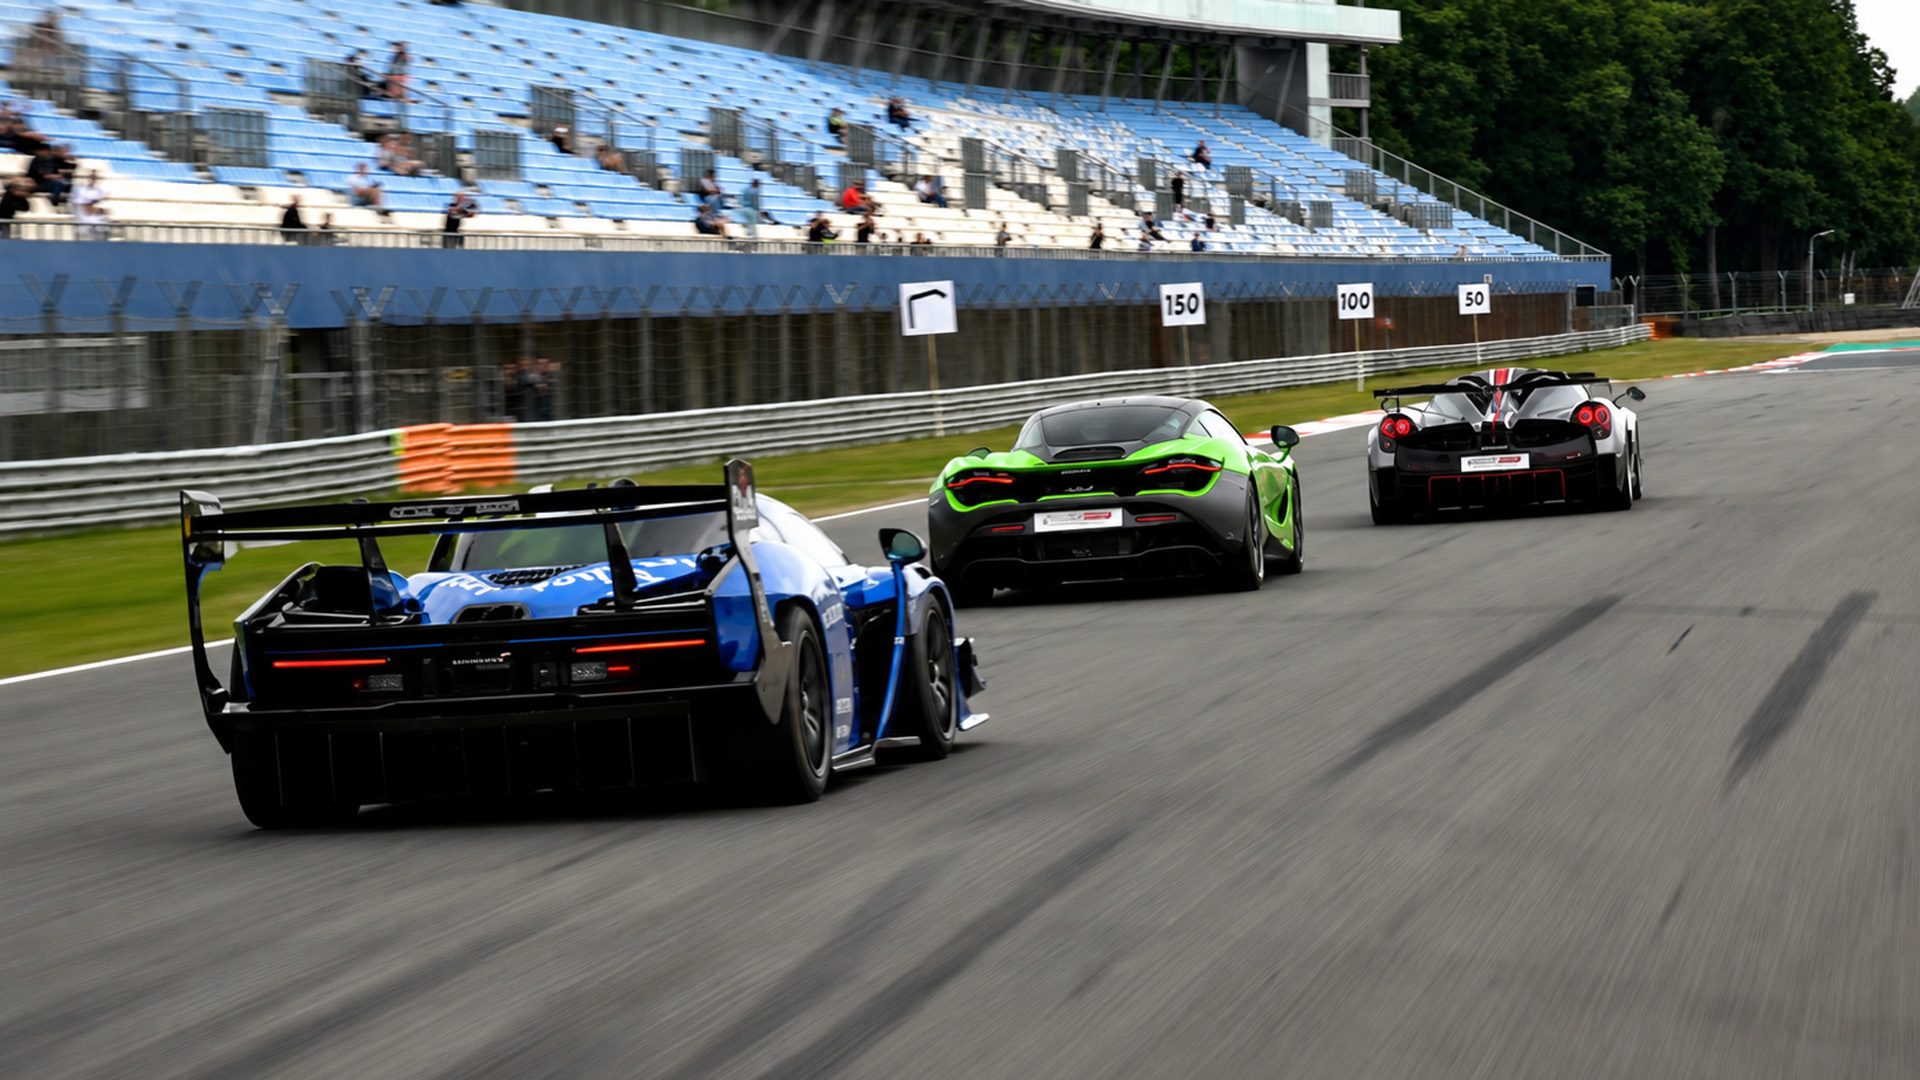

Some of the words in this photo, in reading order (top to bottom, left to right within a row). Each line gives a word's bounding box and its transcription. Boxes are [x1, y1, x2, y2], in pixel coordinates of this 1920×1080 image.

[1165, 293, 1200, 316] 150
[1340, 292, 1370, 310] 100
[1465, 291, 1484, 307] 50
